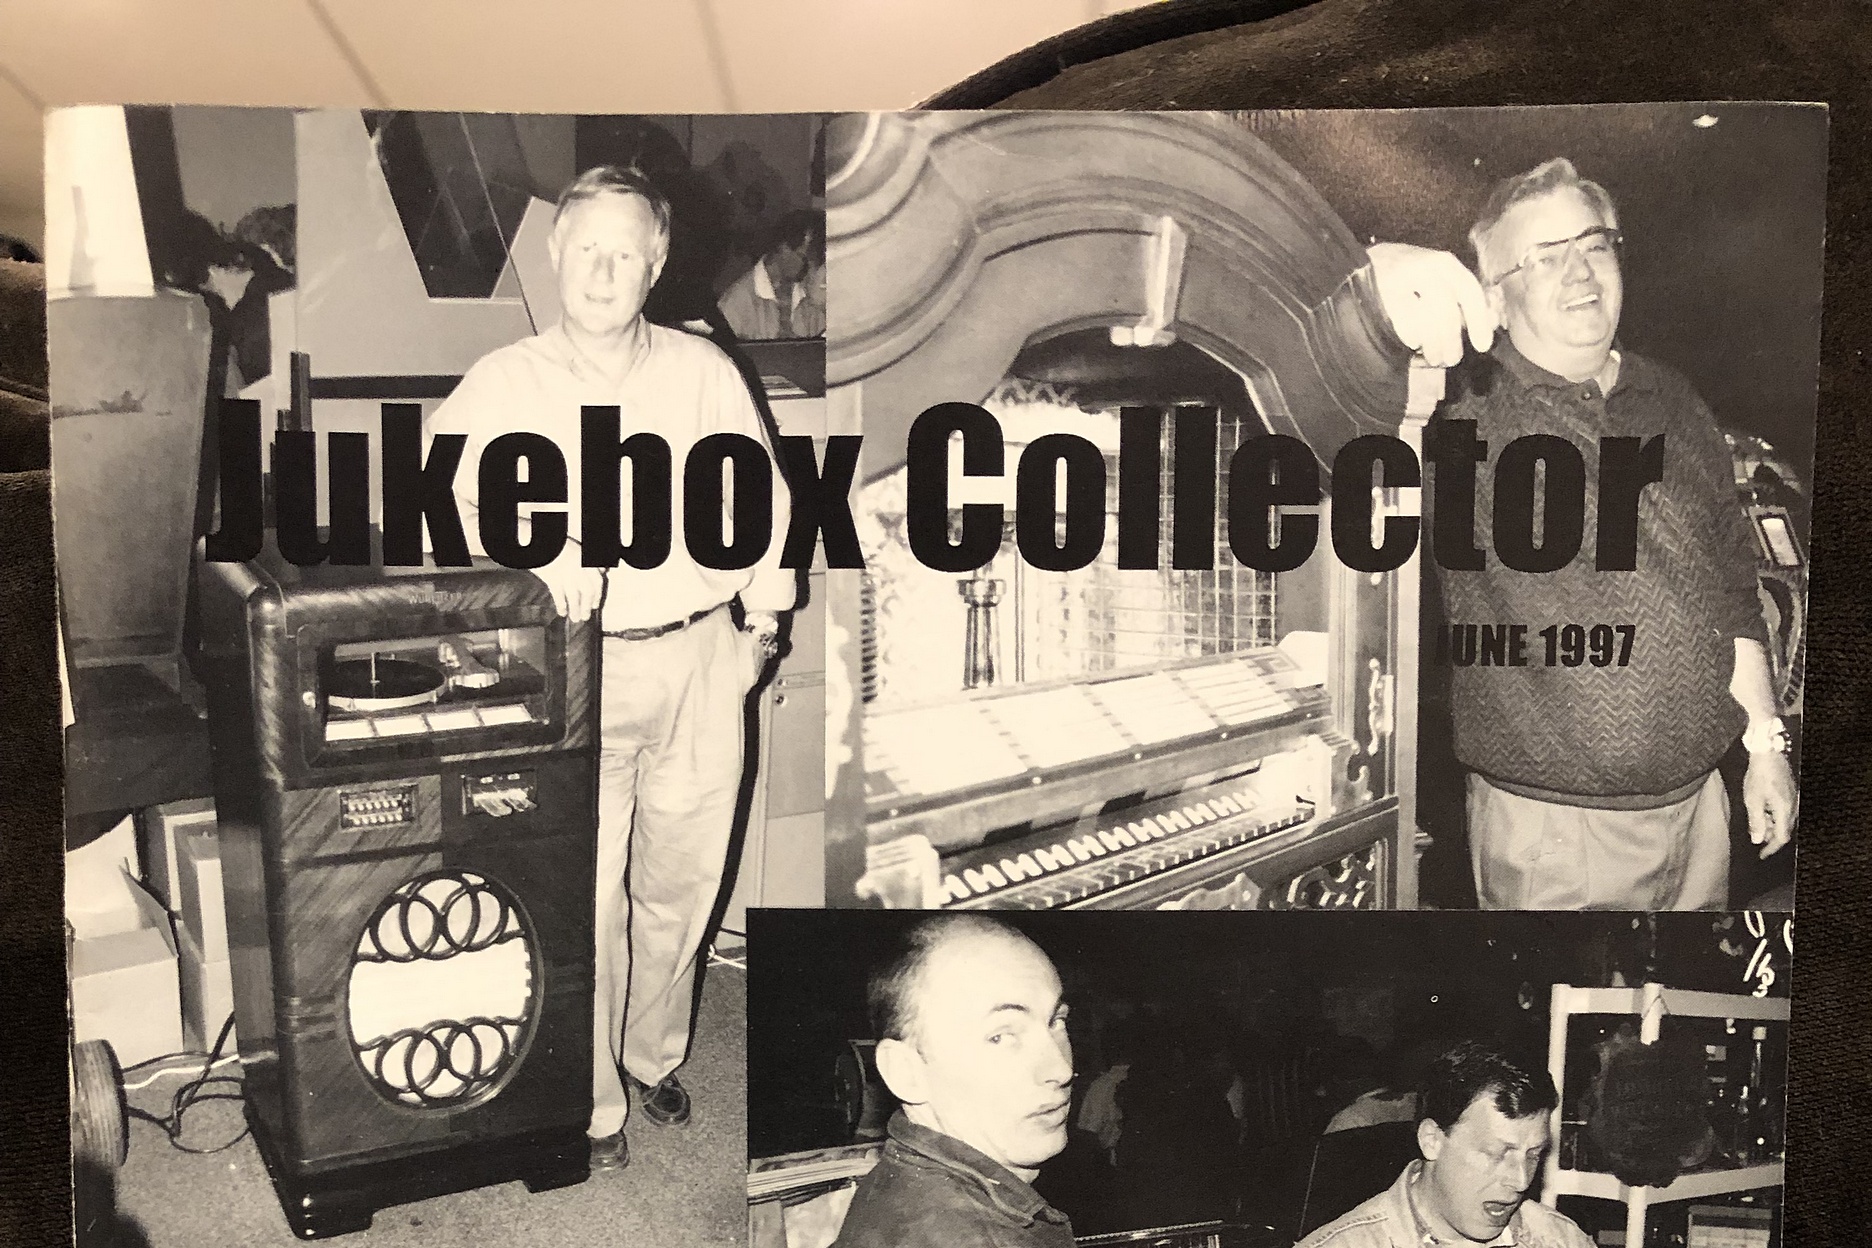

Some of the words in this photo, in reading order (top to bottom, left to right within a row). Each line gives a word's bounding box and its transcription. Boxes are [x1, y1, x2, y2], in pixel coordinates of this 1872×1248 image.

[205, 398, 866, 571] Jukebox
[906, 401, 1666, 574] Collector
[1435, 623, 1528, 668] JUNE
[1538, 623, 1637, 668] 1997
